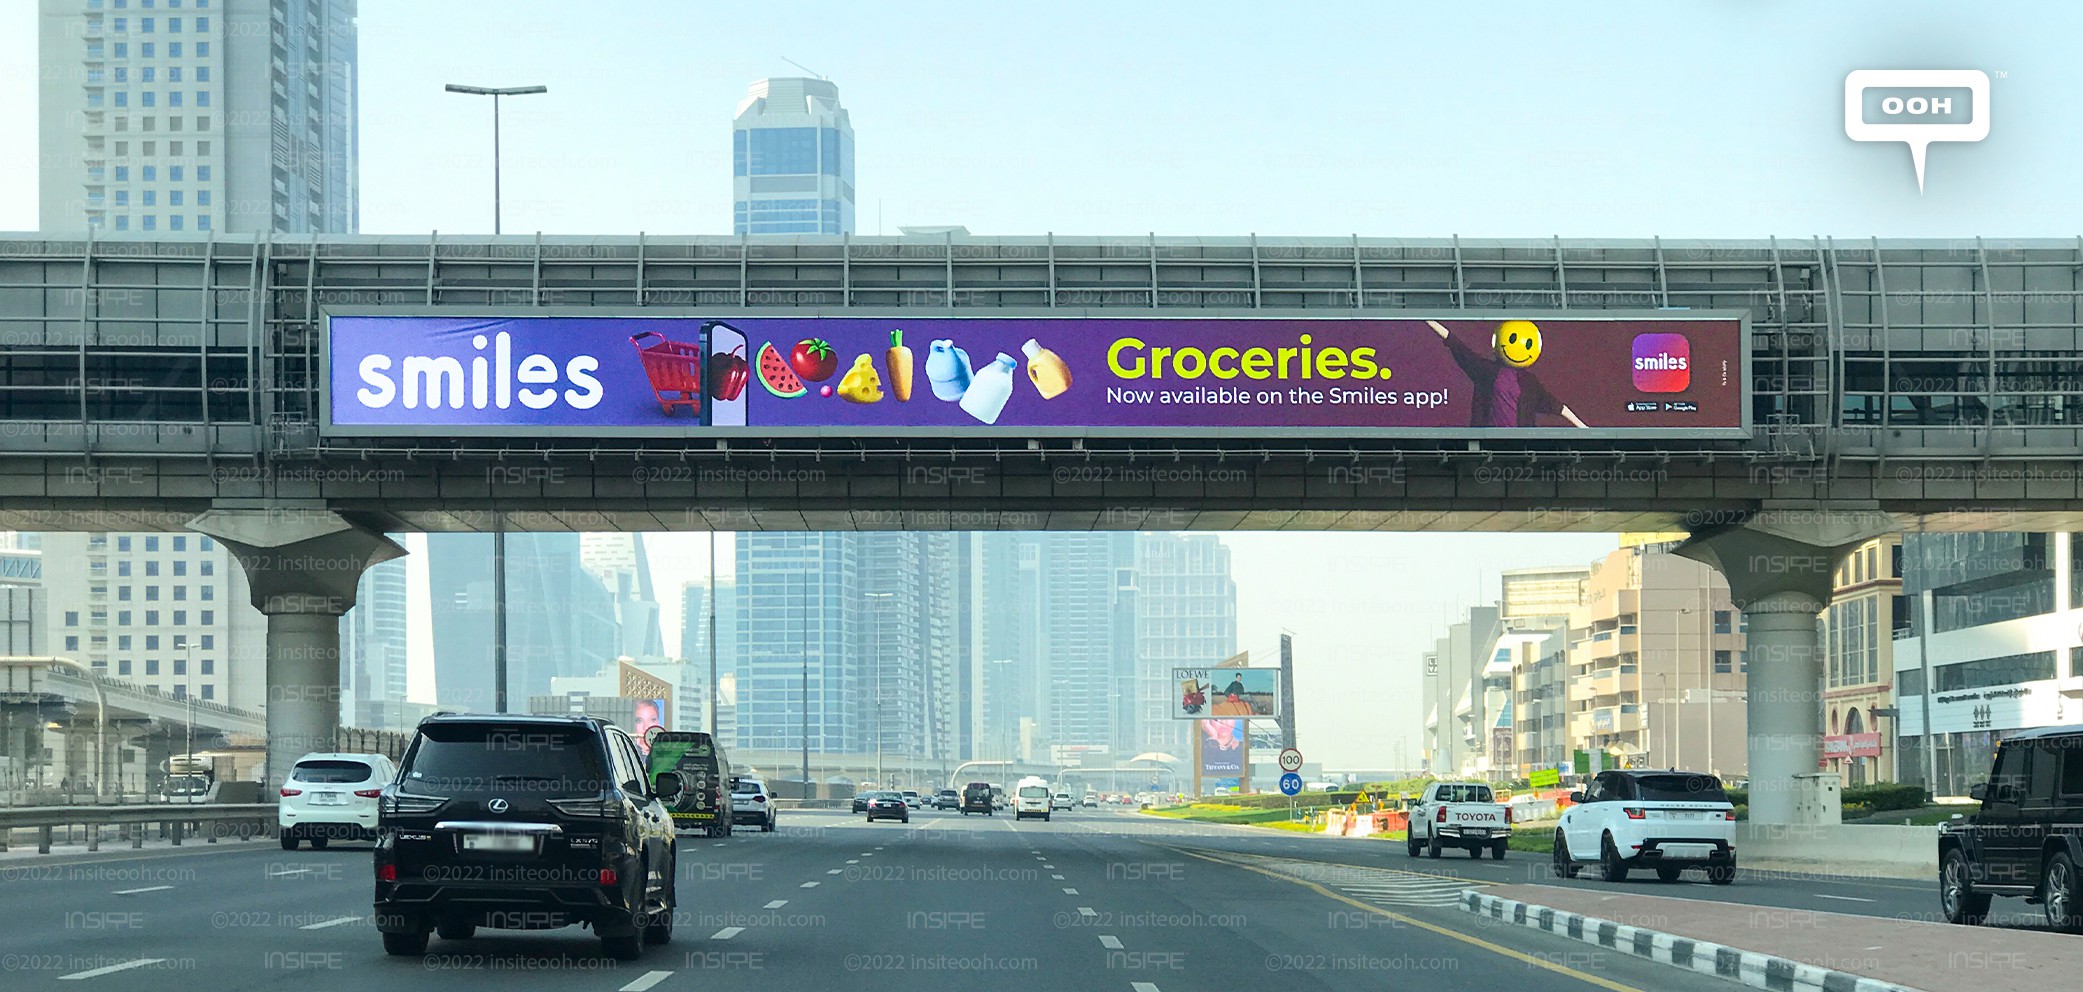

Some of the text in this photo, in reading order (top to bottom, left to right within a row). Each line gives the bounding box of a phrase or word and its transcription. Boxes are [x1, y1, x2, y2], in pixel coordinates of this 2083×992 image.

[1107, 334, 1392, 379] Groceries.
[1634, 352, 1688, 370] smiles
[357, 331, 604, 410] smiles
[1106, 386, 1449, 409] Now available on the Smiles app!
[1176, 670, 1209, 679] LOEWE
[1282, 755, 1300, 765] 100
[1282, 778, 1300, 790] 60
[1455, 812, 1496, 821] TOYOTA
